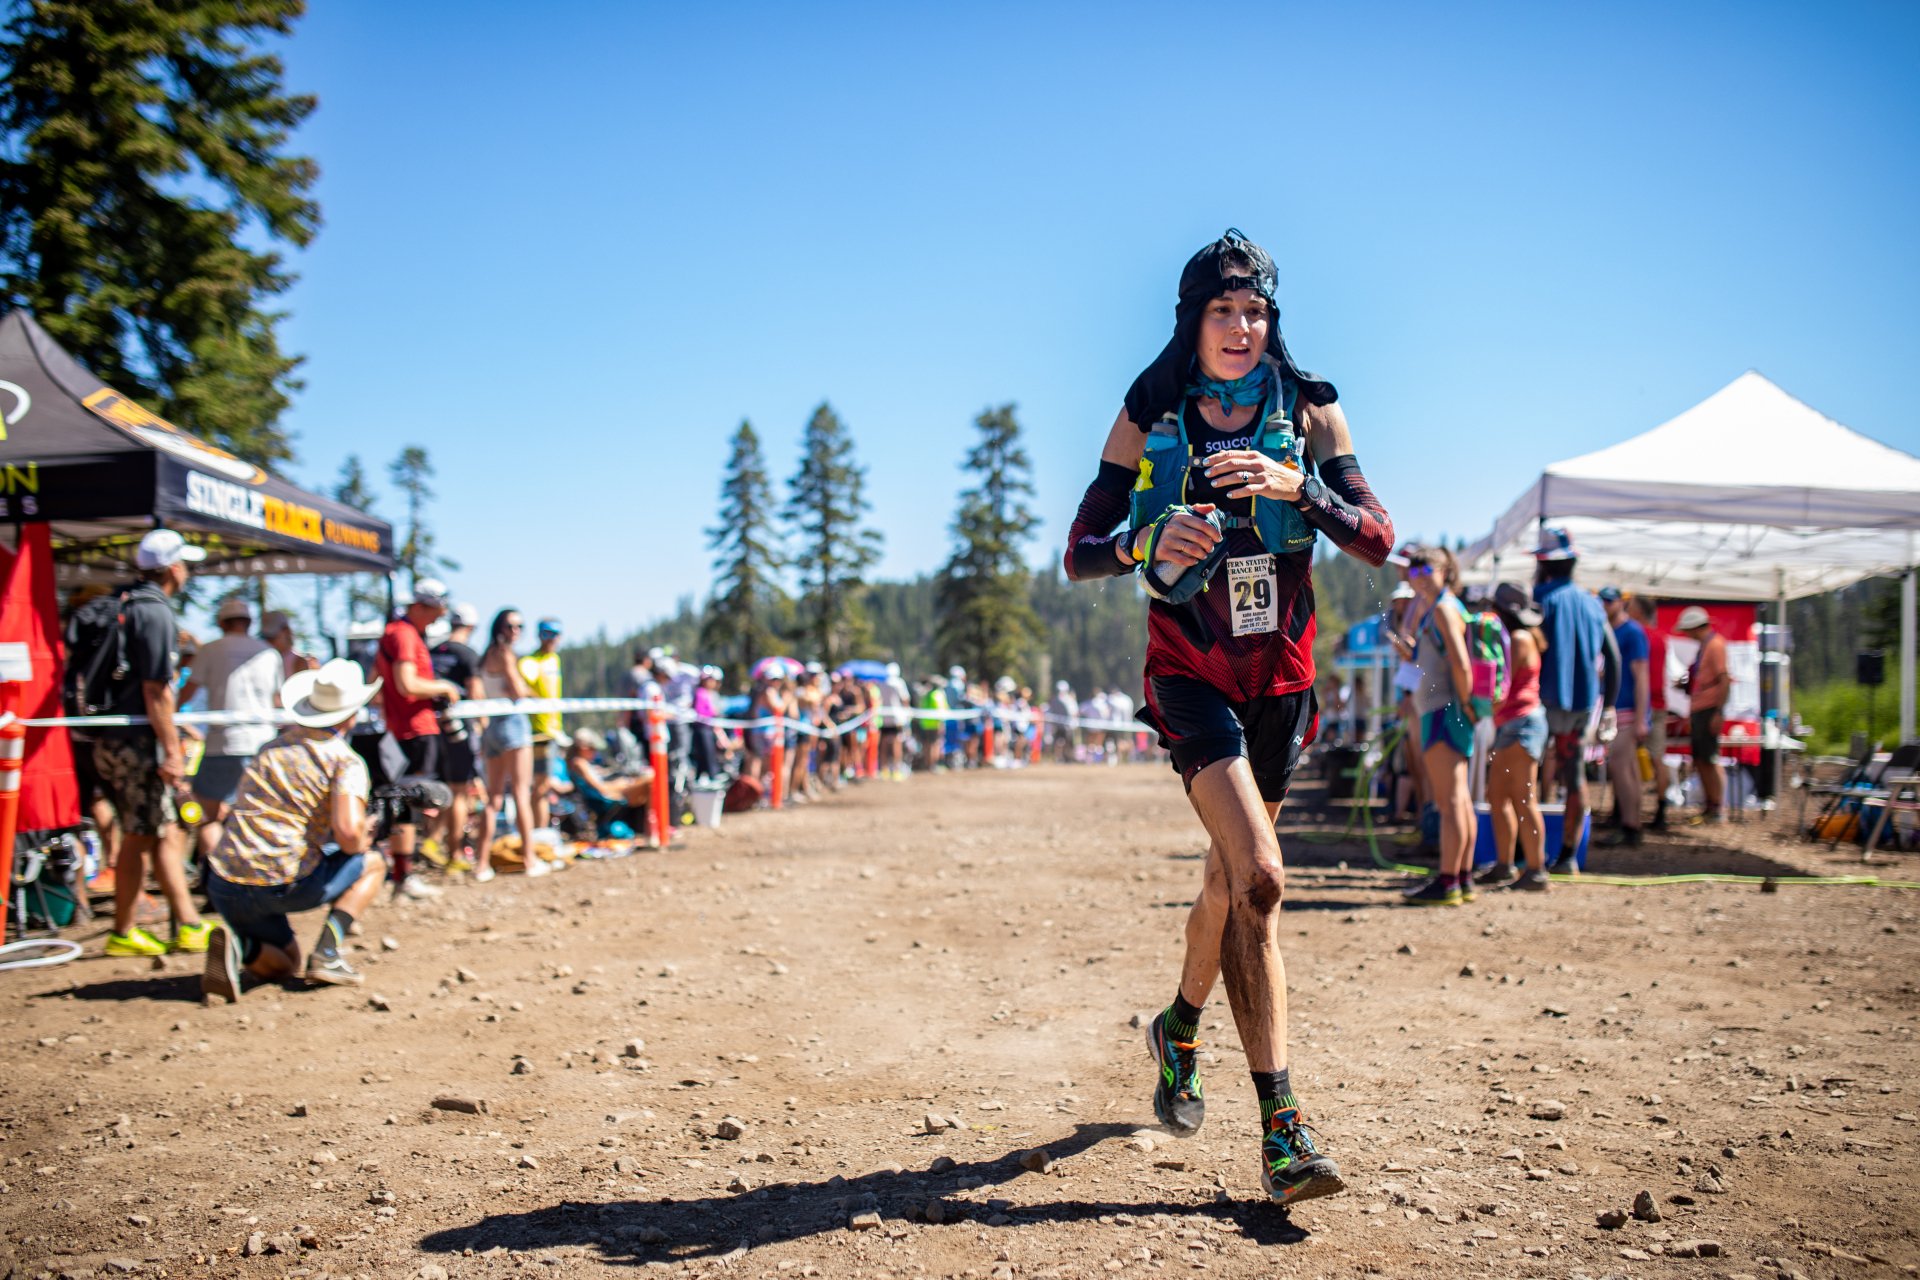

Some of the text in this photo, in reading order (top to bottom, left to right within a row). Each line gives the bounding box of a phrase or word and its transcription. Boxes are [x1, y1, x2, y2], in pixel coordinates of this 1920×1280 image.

[0, 461, 38, 494] N
[324, 518, 381, 554] RUNNING
[1234, 579, 1271, 612] 29
